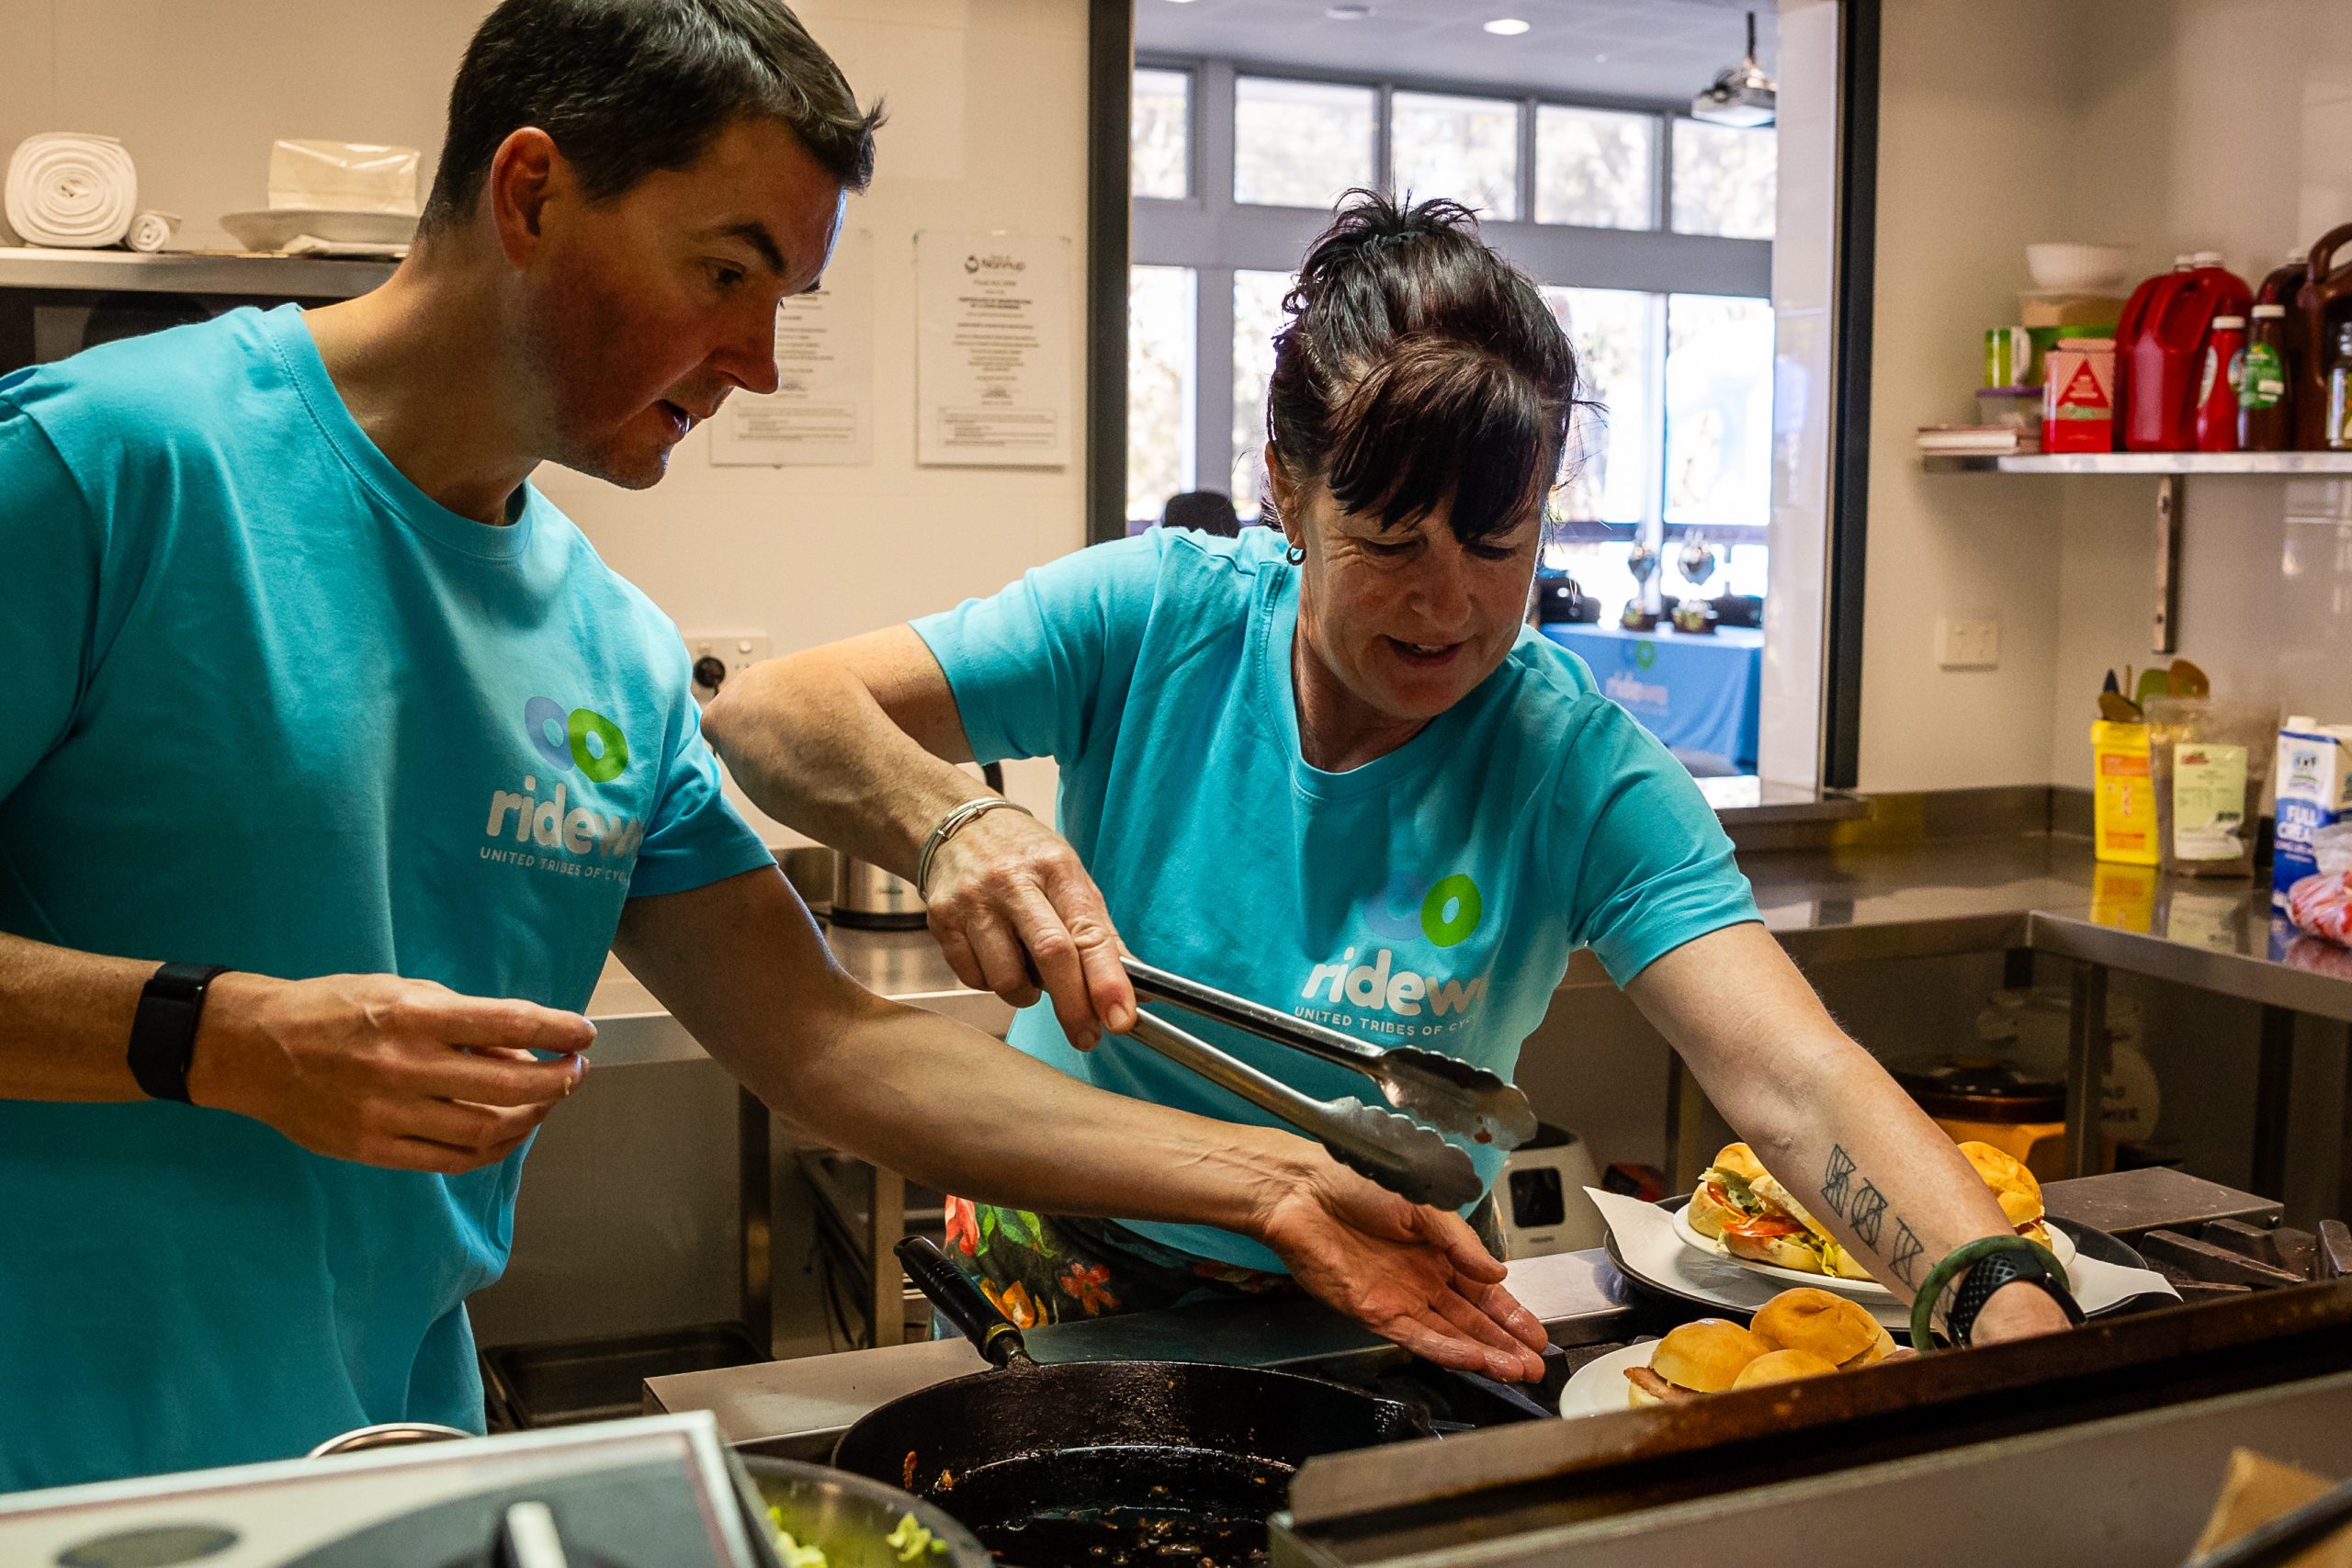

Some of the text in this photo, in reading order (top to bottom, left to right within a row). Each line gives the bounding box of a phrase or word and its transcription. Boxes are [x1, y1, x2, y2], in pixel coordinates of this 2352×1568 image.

[486, 774, 645, 858] ridew
[480, 846, 629, 883] UNITED TRIBES OF CYC
[1301, 946, 1486, 1017] ridew
[1294, 1005, 1472, 1036] UNITED TRIBES OF CYC
